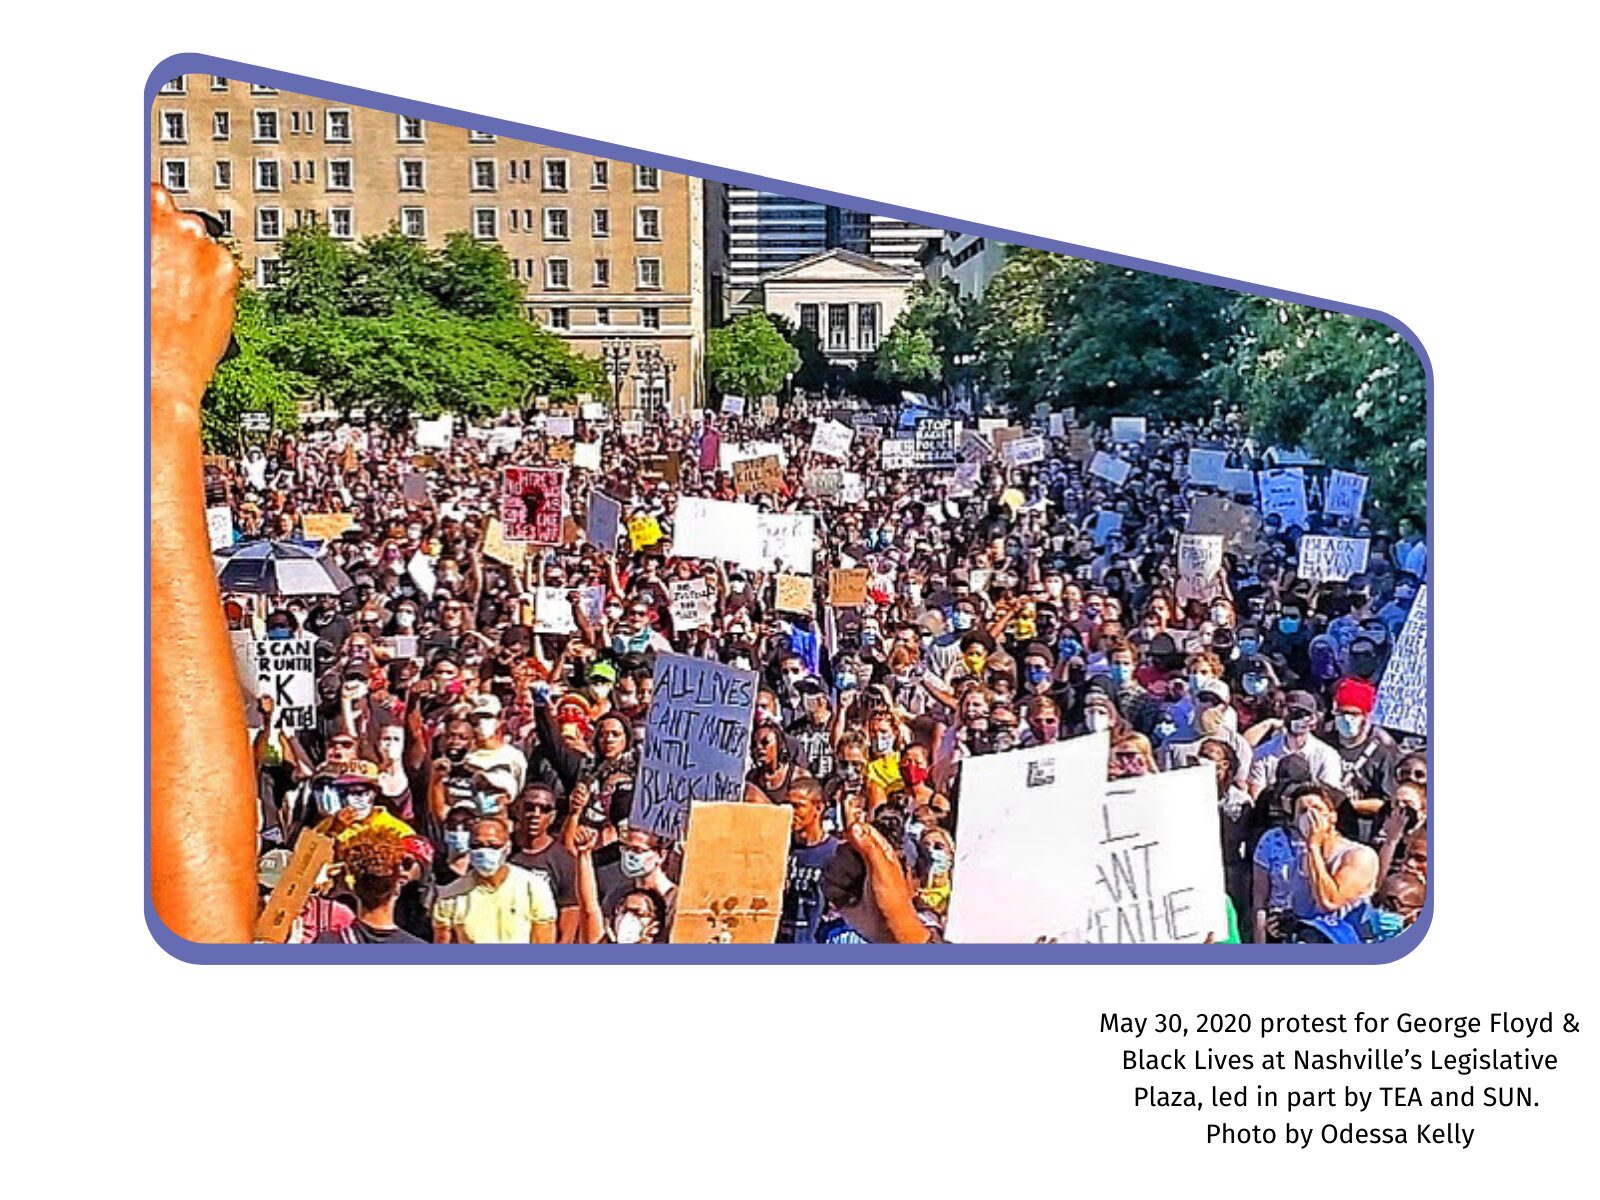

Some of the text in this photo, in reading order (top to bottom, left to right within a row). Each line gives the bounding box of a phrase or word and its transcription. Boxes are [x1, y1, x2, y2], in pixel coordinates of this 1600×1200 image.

[917, 418, 952, 430] STOP
[653, 664, 752, 707] ALL LIVES
[641, 766, 704, 820] BLACK
[1096, 841, 1160, 903] ANT
